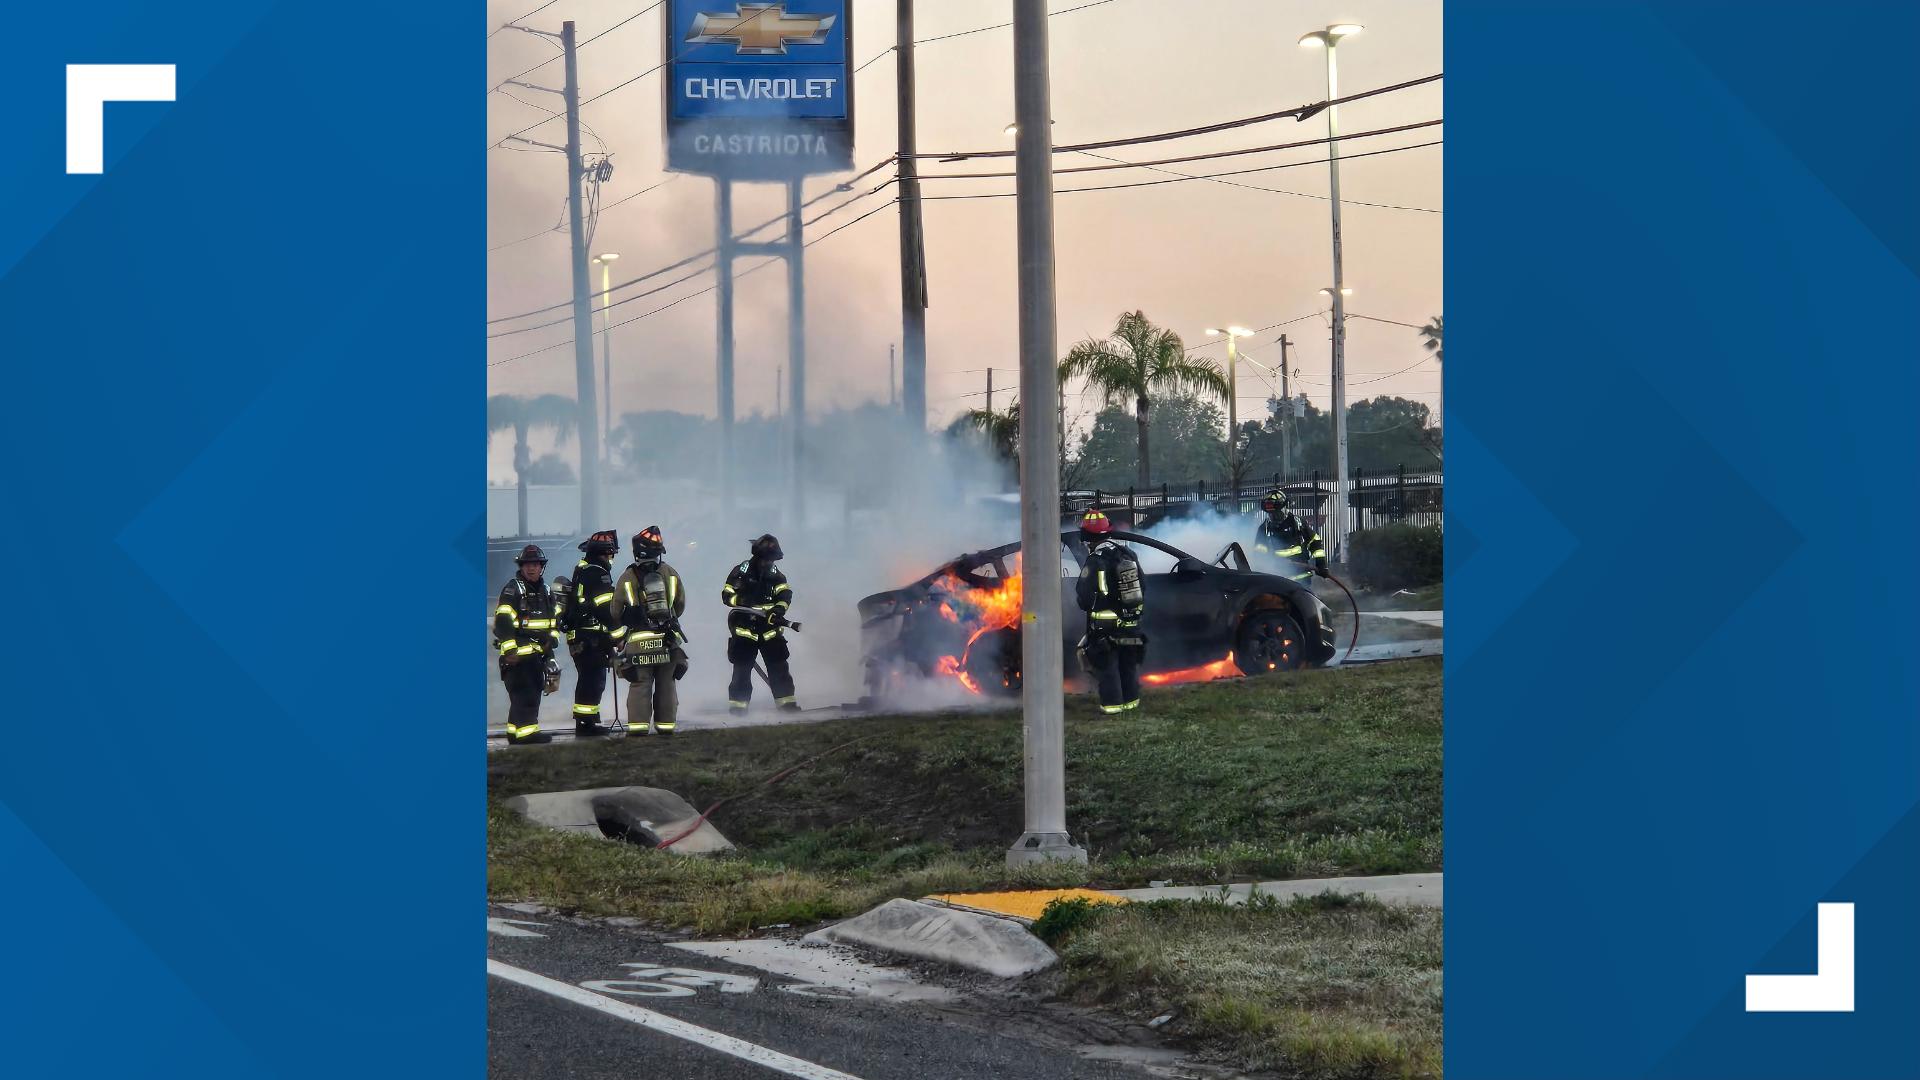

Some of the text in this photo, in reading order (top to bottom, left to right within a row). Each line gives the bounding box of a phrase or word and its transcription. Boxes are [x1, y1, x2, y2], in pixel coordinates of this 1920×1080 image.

[685, 78, 837, 100] CHEVROLET
[694, 134, 828, 155] CASTRIOTA
[639, 639, 663, 650] PASCO
